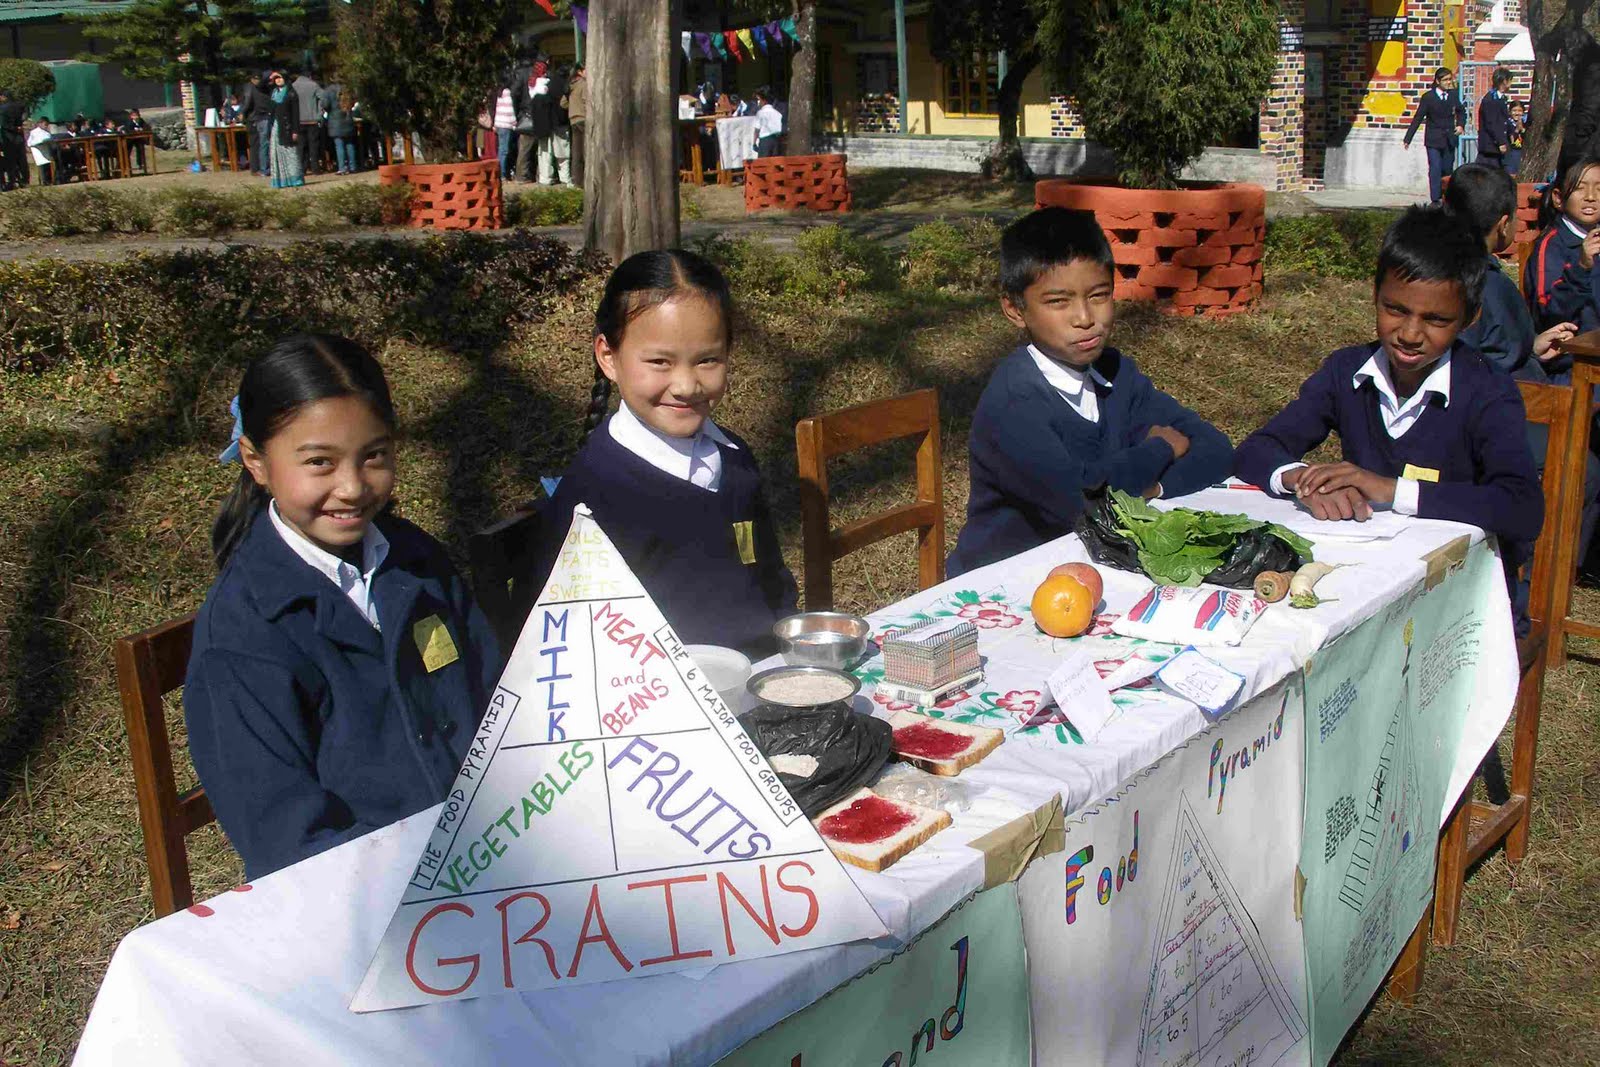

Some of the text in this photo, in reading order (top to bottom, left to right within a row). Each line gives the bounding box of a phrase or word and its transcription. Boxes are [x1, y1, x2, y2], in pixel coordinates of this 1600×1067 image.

[561, 550, 609, 569] FATS
[568, 528, 602, 546] OILS
[549, 579, 621, 601] SWEETS
[593, 602, 667, 666] MEAT
[536, 609, 573, 742] MILK
[602, 678, 669, 735] BEANS
[611, 669, 646, 688] and
[664, 630, 796, 817] THE 6 MAJOR FOOD GROUPS
[414, 693, 505, 881] THE FOOD PYRAMID
[437, 741, 594, 895] VEGETABLES
[607, 736, 771, 859] FRUITS
[1065, 810, 1139, 925] Food
[1208, 689, 1290, 815] Pyramid
[405, 860, 820, 997] GRAINS
[1220, 979, 1232, 1000] to
[1167, 1024, 1179, 1042] to
[1181, 1012, 1188, 1032] 5
